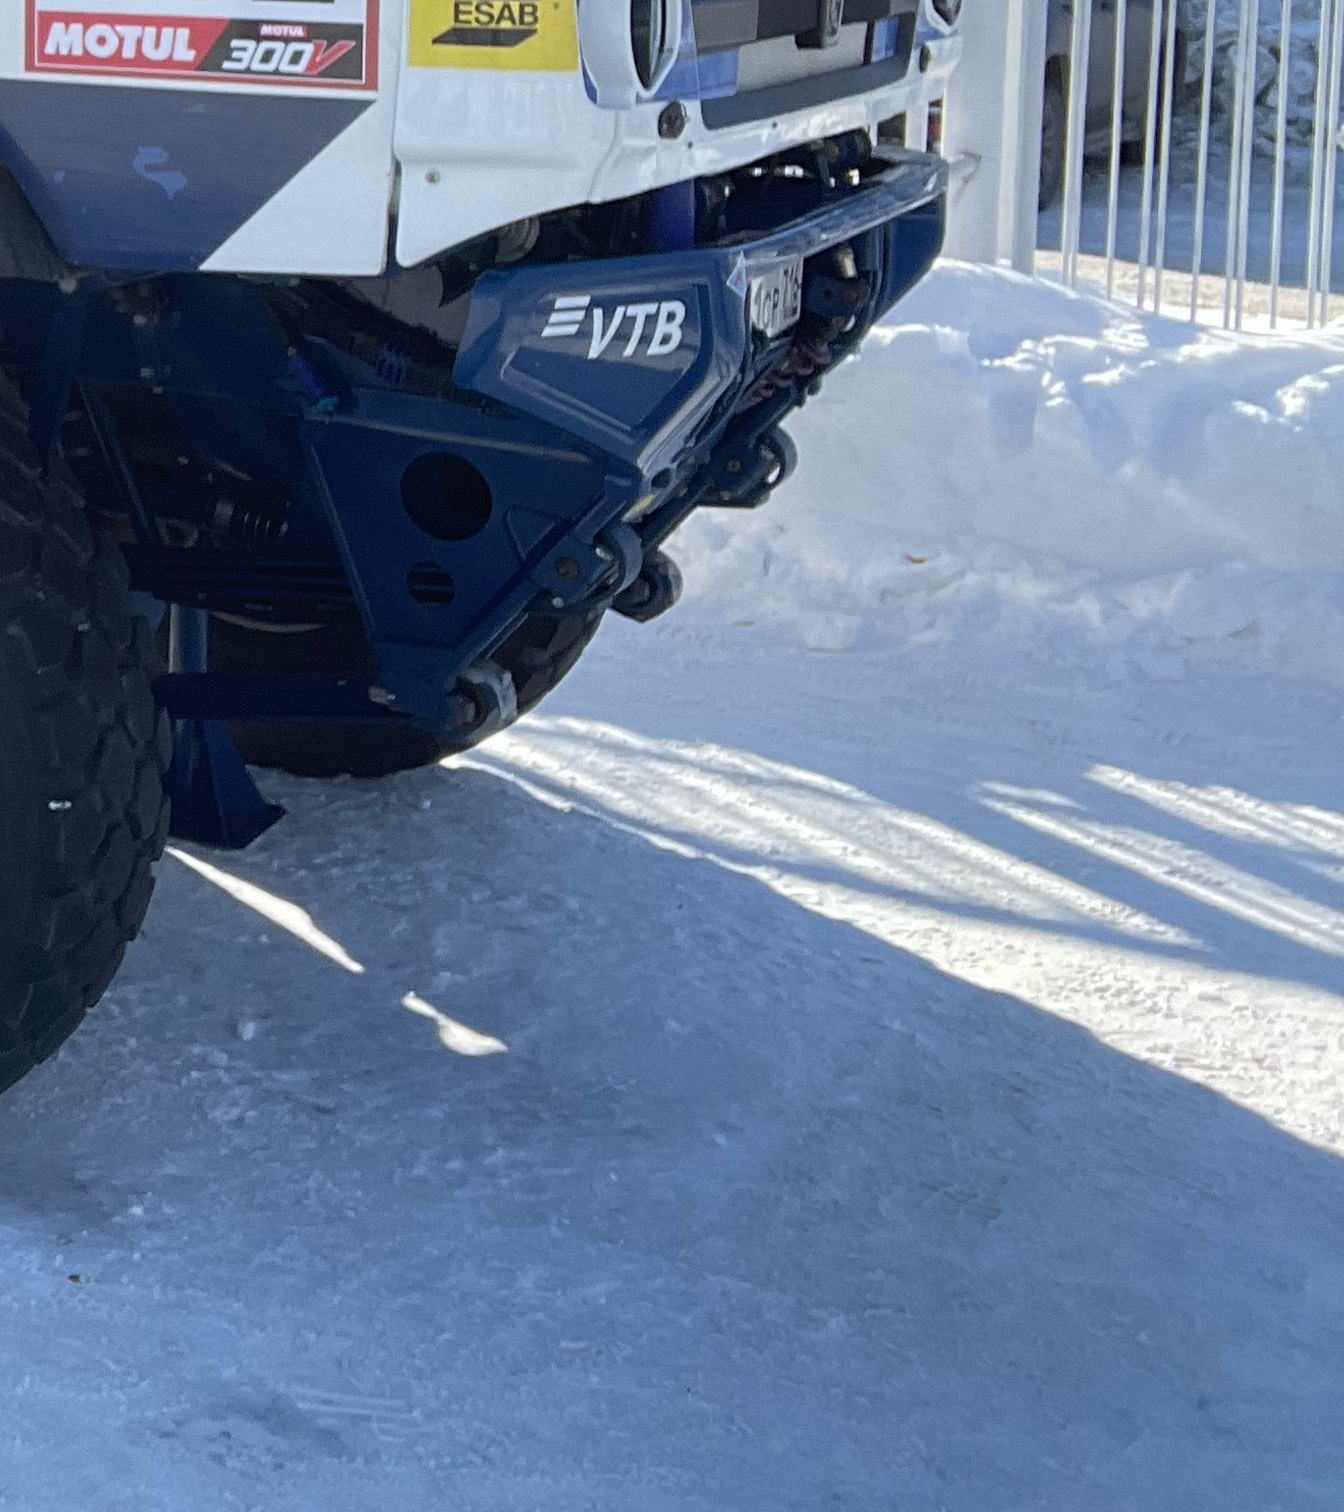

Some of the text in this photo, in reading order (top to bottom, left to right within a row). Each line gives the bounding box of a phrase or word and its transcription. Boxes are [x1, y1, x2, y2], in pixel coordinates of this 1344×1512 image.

[44, 22, 196, 61] MOTUL
[222, 39, 357, 76] 300V
[587, 299, 686, 360] VTB
